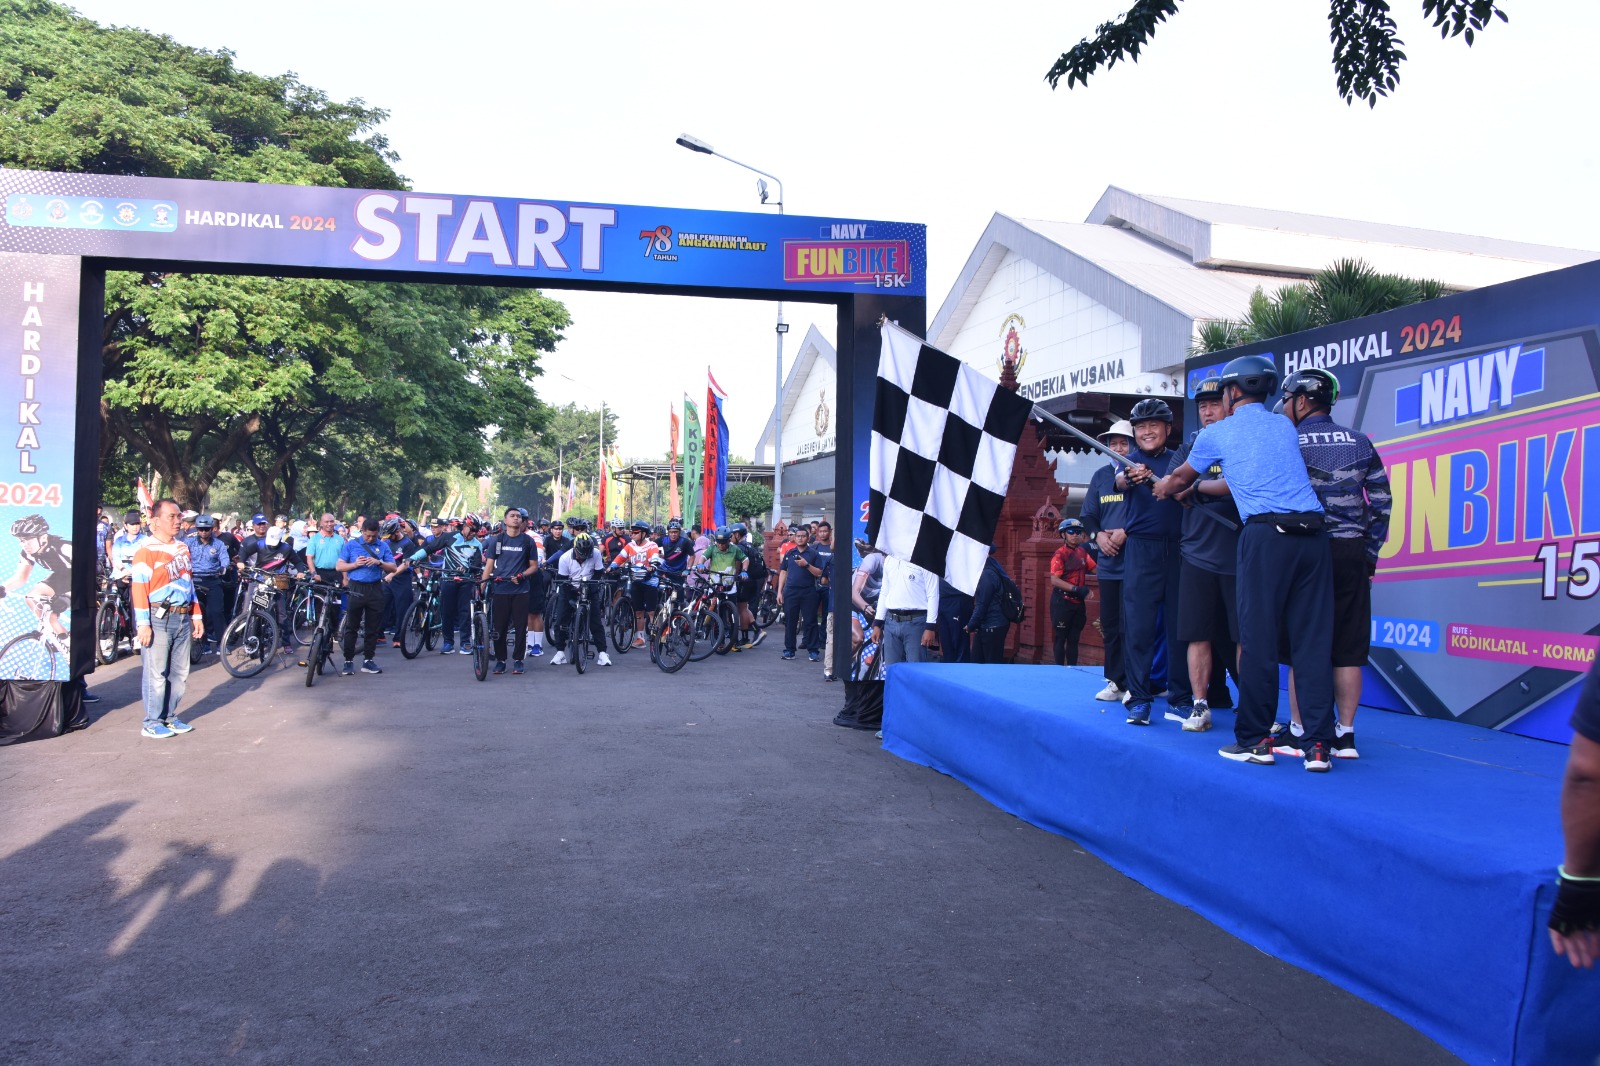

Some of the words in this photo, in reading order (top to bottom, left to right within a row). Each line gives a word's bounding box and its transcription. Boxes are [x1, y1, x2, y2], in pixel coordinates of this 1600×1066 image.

[185, 210, 284, 229] HARDIKAL
[289, 215, 337, 231] 2024
[830, 224, 867, 239] NAVY
[352, 193, 616, 271] START
[639, 225, 672, 257] 78
[678, 232, 698, 241] HARI
[699, 233, 748, 243] PENDIDIKAN
[678, 238, 737, 249] ANGKATAN
[739, 242, 767, 251] LAUT
[874, 274, 906, 288] 15K
[1284, 331, 1393, 376] HARDIKAL
[1400, 315, 1462, 353] 2024
[17, 281, 44, 473] HARDIKAL
[1018, 374, 1066, 400] ENDEKIA
[1070, 358, 1125, 388] WUSANA
[1420, 344, 1522, 427] NAVY
[1298, 431, 1357, 445] STTAL
[0, 484, 61, 506] 2024
[1383, 621, 1431, 648] 2024
[1452, 626, 1468, 635] RUTE
[1451, 634, 1529, 656] KODIKLATAL
